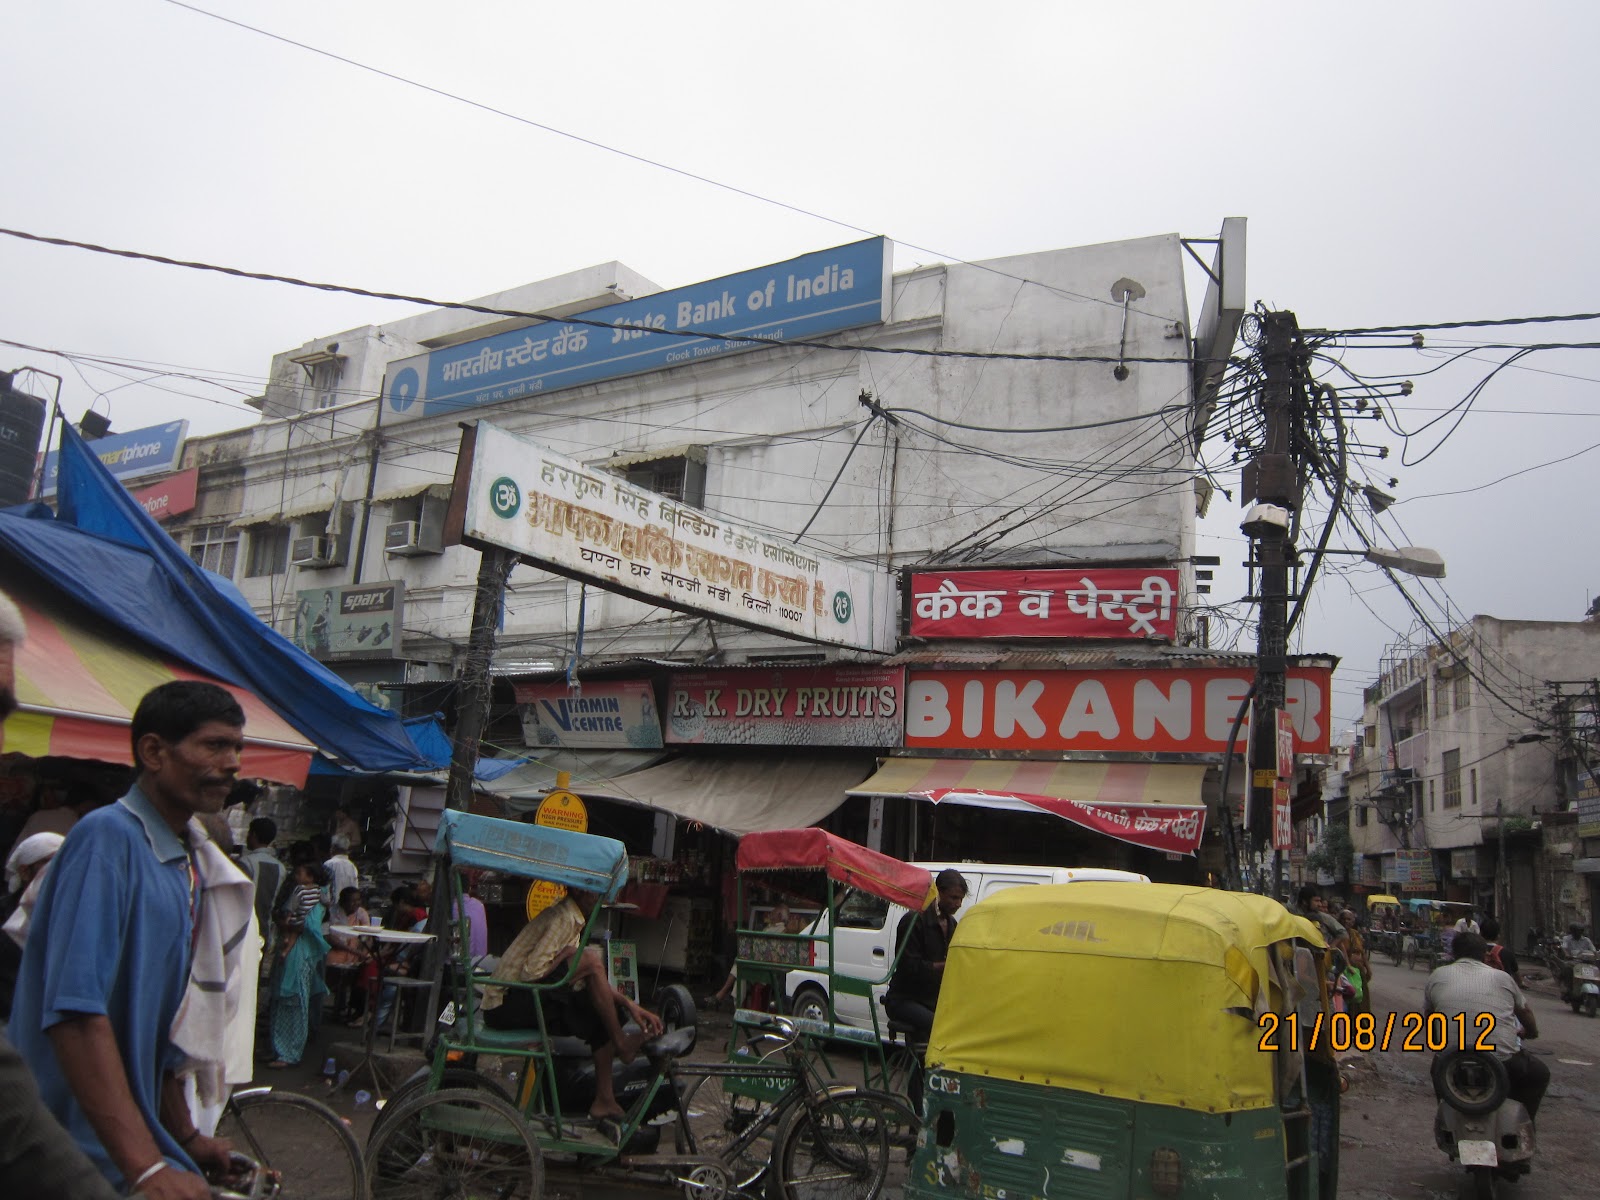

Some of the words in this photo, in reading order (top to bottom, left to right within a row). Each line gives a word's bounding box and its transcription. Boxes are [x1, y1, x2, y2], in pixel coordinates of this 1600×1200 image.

[611, 311, 667, 345] State
[677, 291, 736, 329] Bank
[746, 279, 776, 311] of
[786, 263, 855, 303] India
[443, 347, 504, 382] भारतीय
[505, 336, 550, 367] स्टेट
[551, 325, 589, 356] बैंक
[665, 350, 691, 363] Clock
[100, 441, 161, 466] martphone
[540, 458, 606, 500] हरफुल
[613, 481, 653, 520] सिंह
[525, 490, 622, 553] आपका
[685, 544, 756, 593] स्वागत
[578, 546, 622, 571] घण्टा
[629, 562, 652, 581] घर
[660, 571, 702, 595] सब्जी
[707, 583, 731, 603] मंडी
[914, 578, 1008, 621] कैक
[1017, 589, 1055, 619] व
[1064, 576, 1177, 635] पेस्ट्री
[540, 697, 620, 732] VITAMIN
[673, 690, 695, 717] R.
[703, 689, 727, 717] K.
[735, 688, 789, 717] DRY
[795, 686, 897, 718] FRUITS
[906, 678, 1321, 743] BIKANER
[572, 716, 624, 732] CENTRE
[541, 813, 556, 821] HIGH
[557, 815, 583, 825] PRESSURE
[543, 807, 584, 820] WARNING
[928, 1073, 961, 1095] CNG
